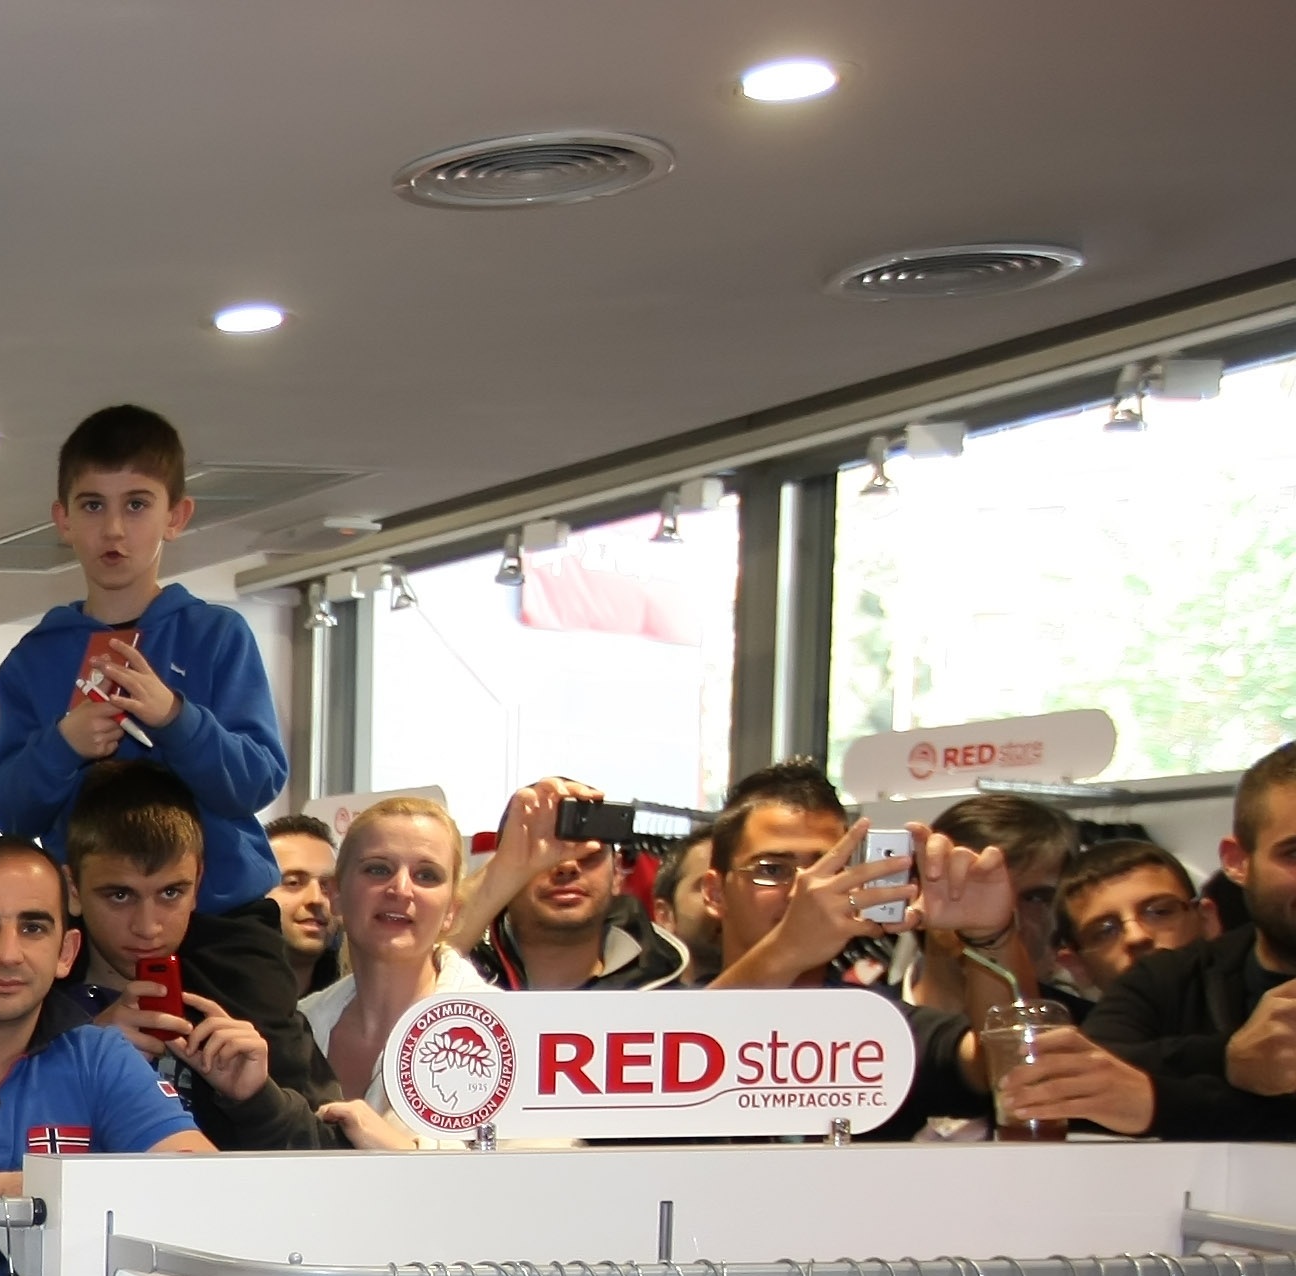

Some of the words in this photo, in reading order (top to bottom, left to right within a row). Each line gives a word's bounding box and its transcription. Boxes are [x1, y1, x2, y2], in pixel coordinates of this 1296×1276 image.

[943, 743, 996, 769] RED
[416, 1003, 499, 1031] ΟΛΥΜΠΙΑΚΟΣ
[537, 1031, 726, 1096] RED
[736, 1030, 884, 1085] store
[468, 1082, 488, 1094] 1925
[737, 1092, 852, 1109] OLYMPIACOS
[857, 1091, 887, 1107] F.C.
